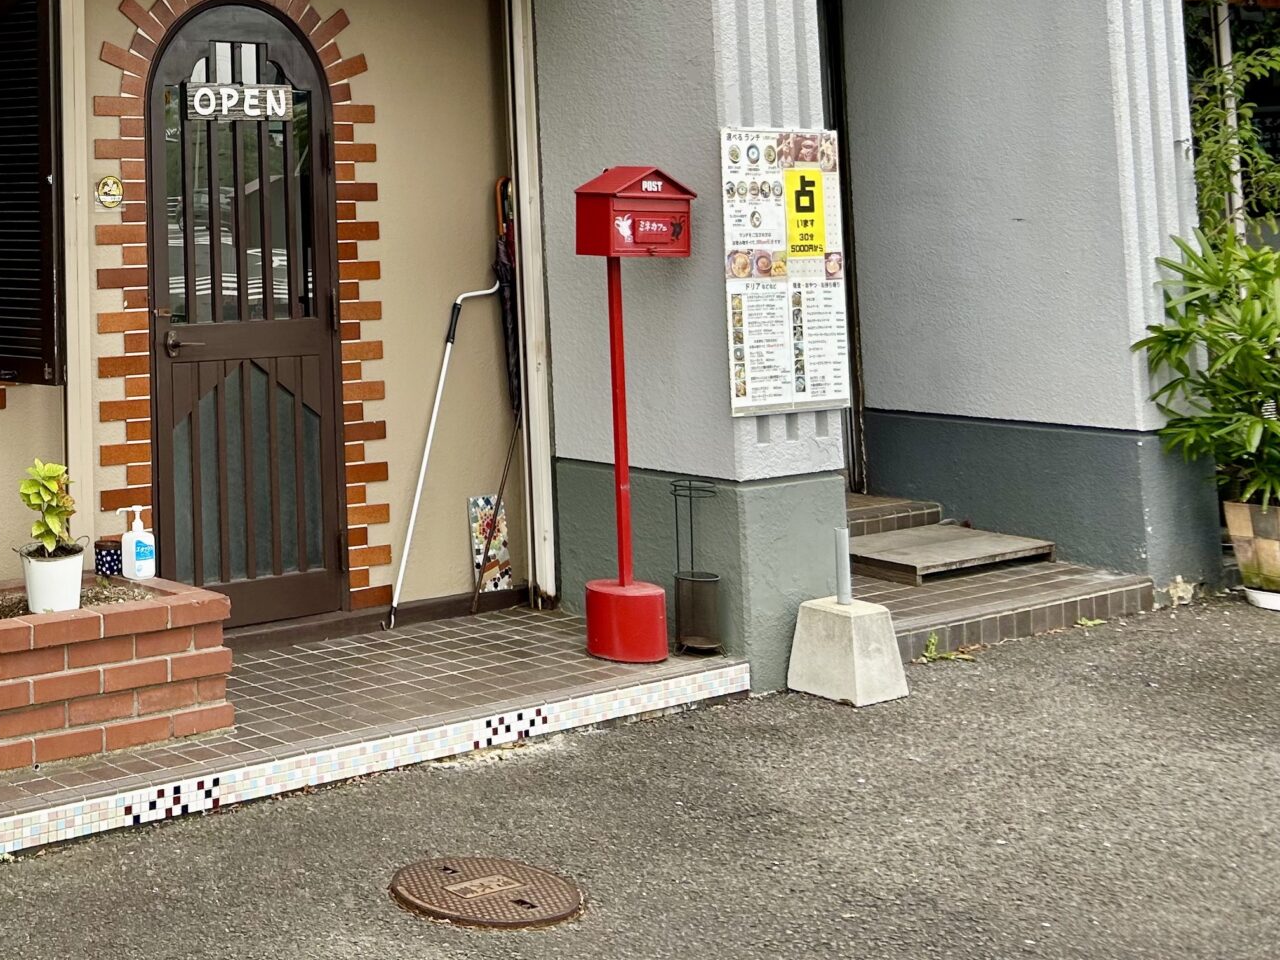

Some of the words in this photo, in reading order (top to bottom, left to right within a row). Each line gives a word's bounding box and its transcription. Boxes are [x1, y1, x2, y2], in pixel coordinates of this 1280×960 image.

[193, 87, 287, 117] OPEN
[641, 180, 663, 192] POST
[794, 175, 816, 214] 占
[639, 220, 668, 232] ミネカフェ
